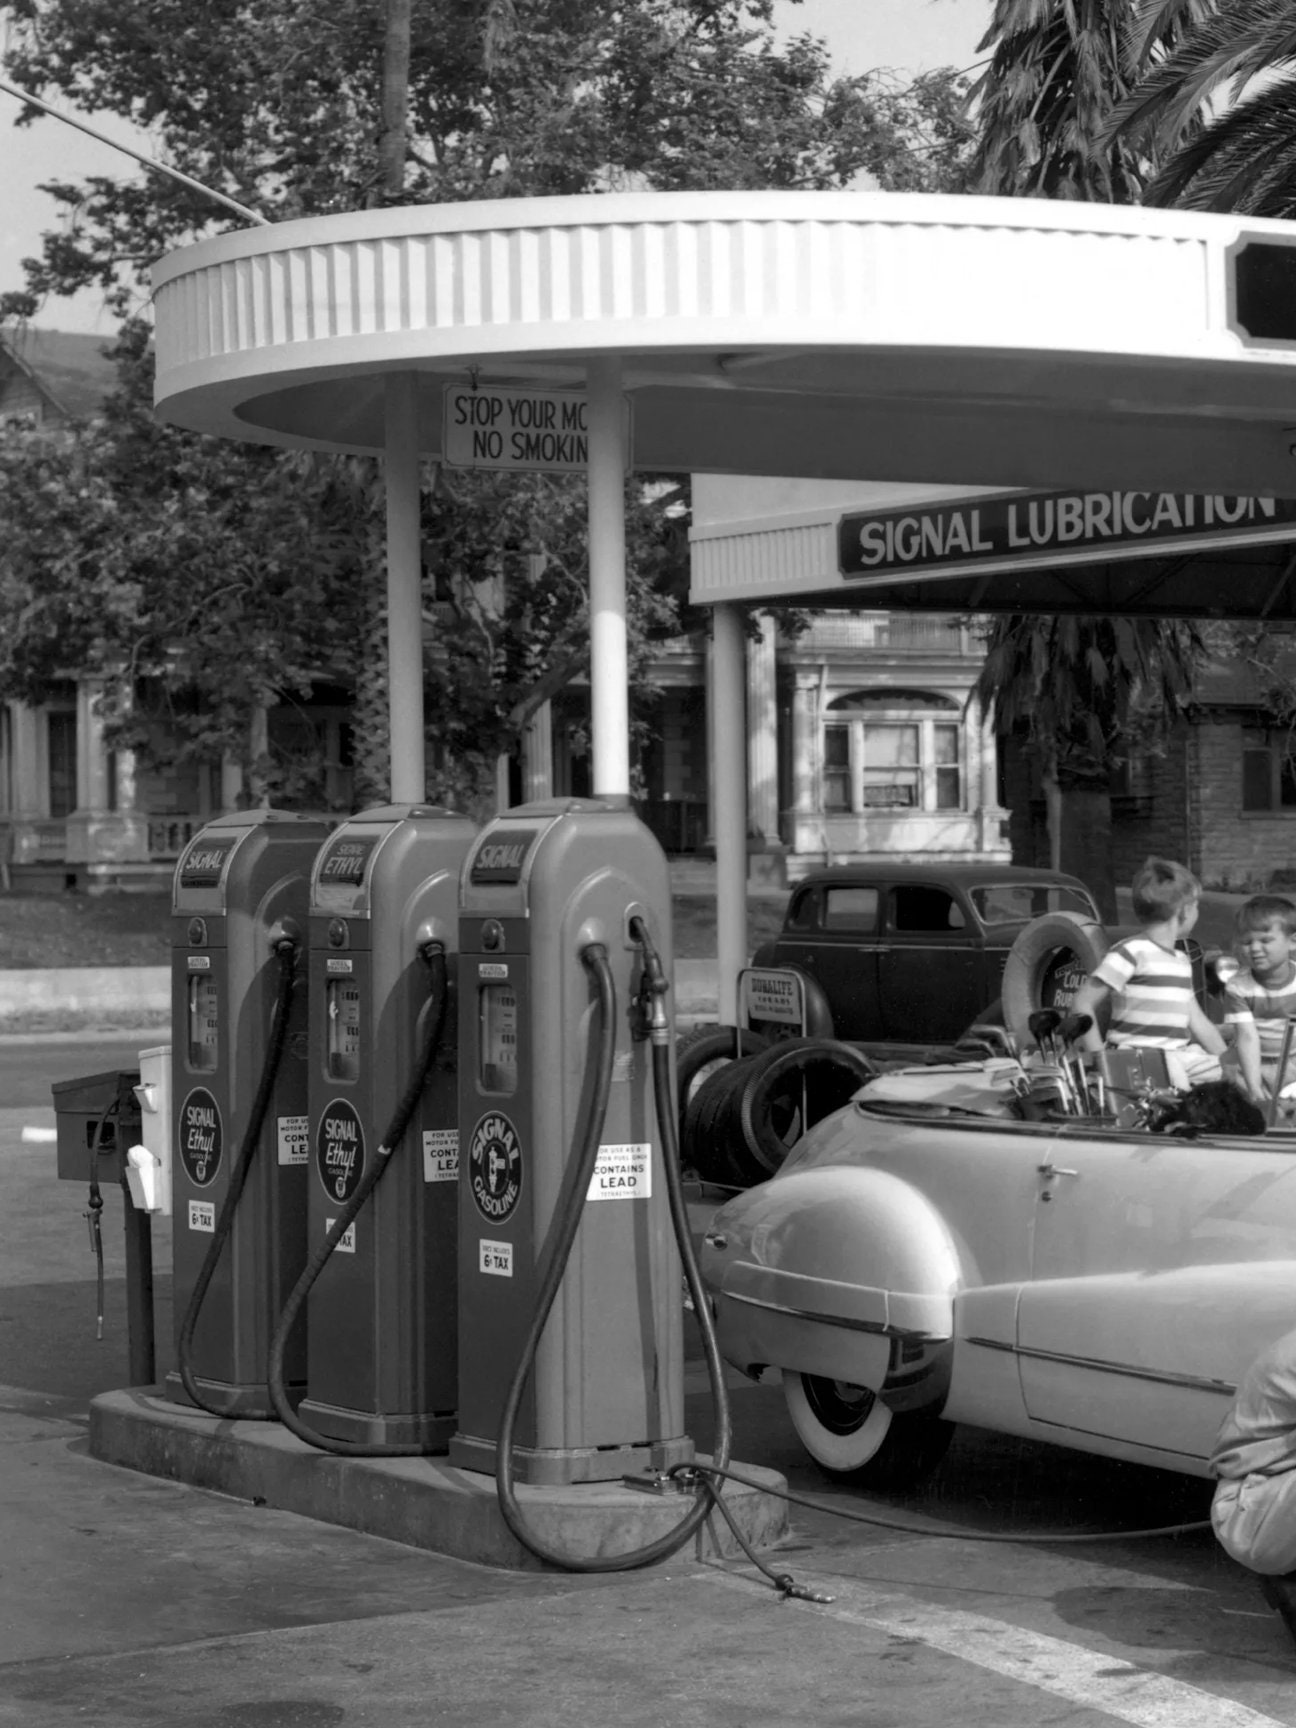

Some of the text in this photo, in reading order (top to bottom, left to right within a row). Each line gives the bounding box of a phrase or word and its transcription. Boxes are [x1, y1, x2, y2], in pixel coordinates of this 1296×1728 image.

[455, 395, 503, 427] STOP
[507, 398, 556, 430] YOUR
[473, 430, 588, 463] NO SMOKIN
[859, 509, 993, 565] SIGNAL
[186, 849, 223, 869] SIGNAL
[324, 857, 364, 874] ETHYL
[476, 844, 524, 868] SIGNAL
[187, 1106, 216, 1128] SIGNAL
[284, 1134, 309, 1143] CONT
[325, 1118, 358, 1142] SIGNAL
[187, 1128, 215, 1165] Ethyl
[291, 1144, 307, 1155] LE
[430, 1149, 458, 1158] CONT
[472, 1117, 520, 1170] SIGNAL
[325, 1142, 357, 1182] Ethyl
[594, 1164, 645, 1174] CONTAINS
[600, 1176, 637, 1189] LEAD
[473, 1175, 519, 1216] GASOLINE
[200, 1214, 212, 1227] TAX
[494, 1256, 509, 1270] TAX
